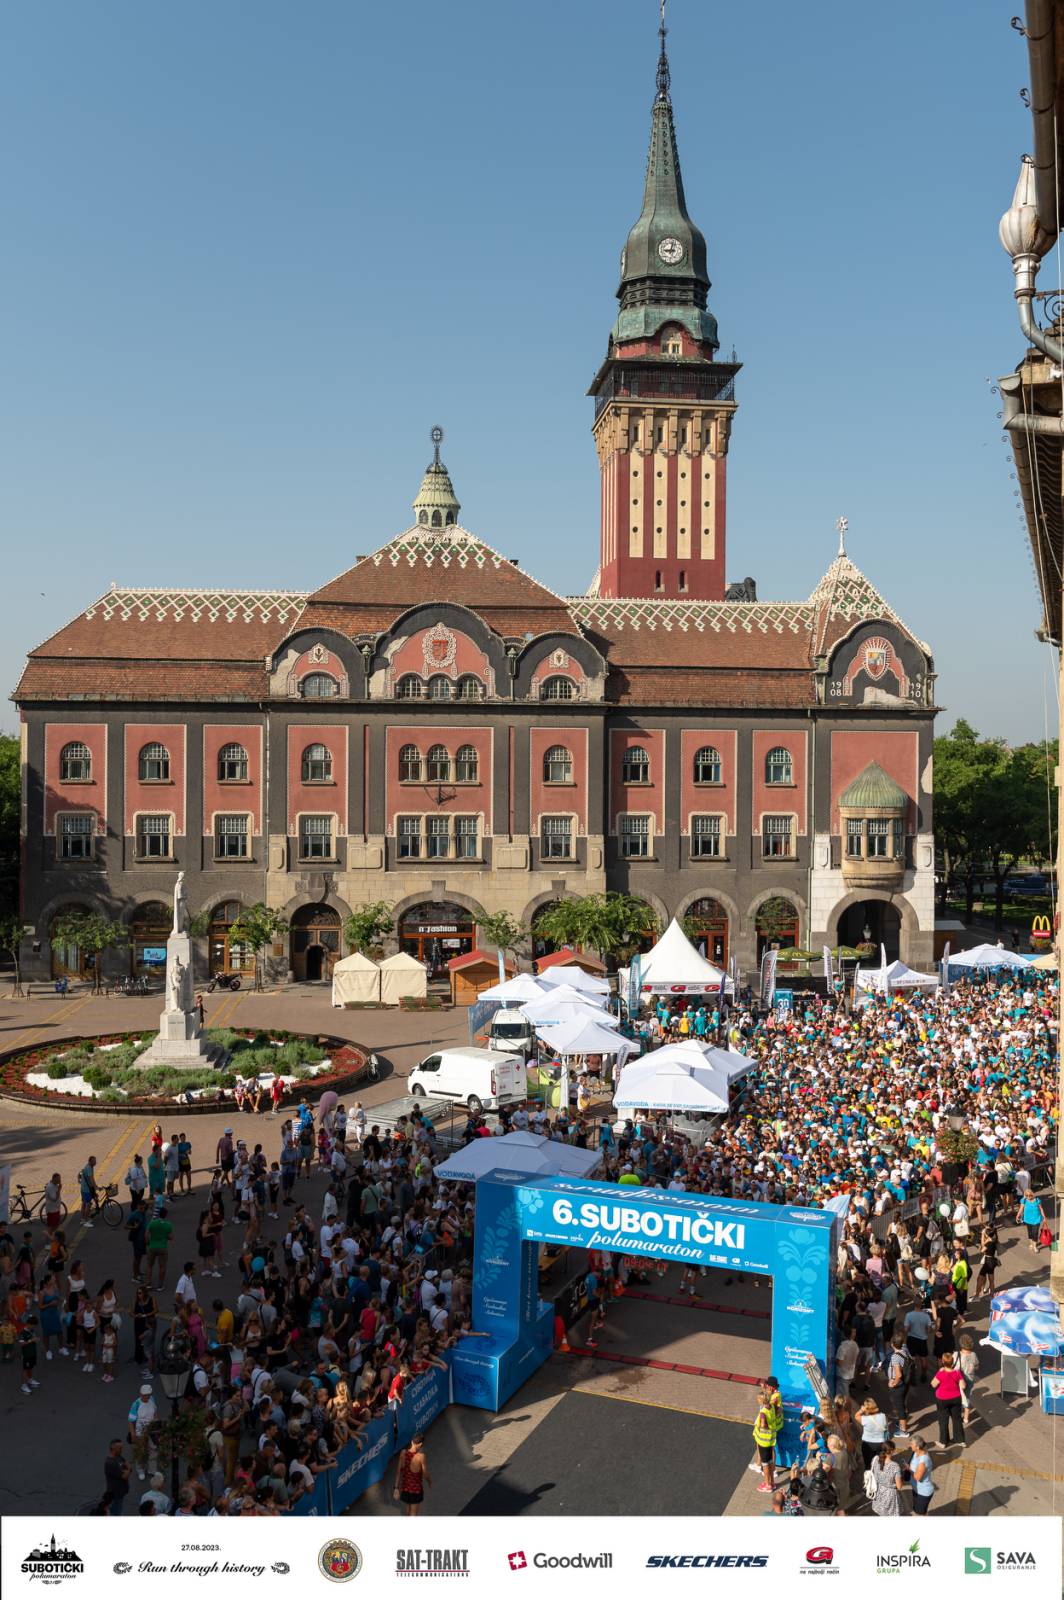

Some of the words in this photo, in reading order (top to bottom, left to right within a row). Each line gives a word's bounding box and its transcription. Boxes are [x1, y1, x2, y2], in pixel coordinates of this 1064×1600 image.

[831, 681, 842, 689] 19
[830, 689, 842, 697] 08
[585, 1231, 704, 1260] polumaraton
